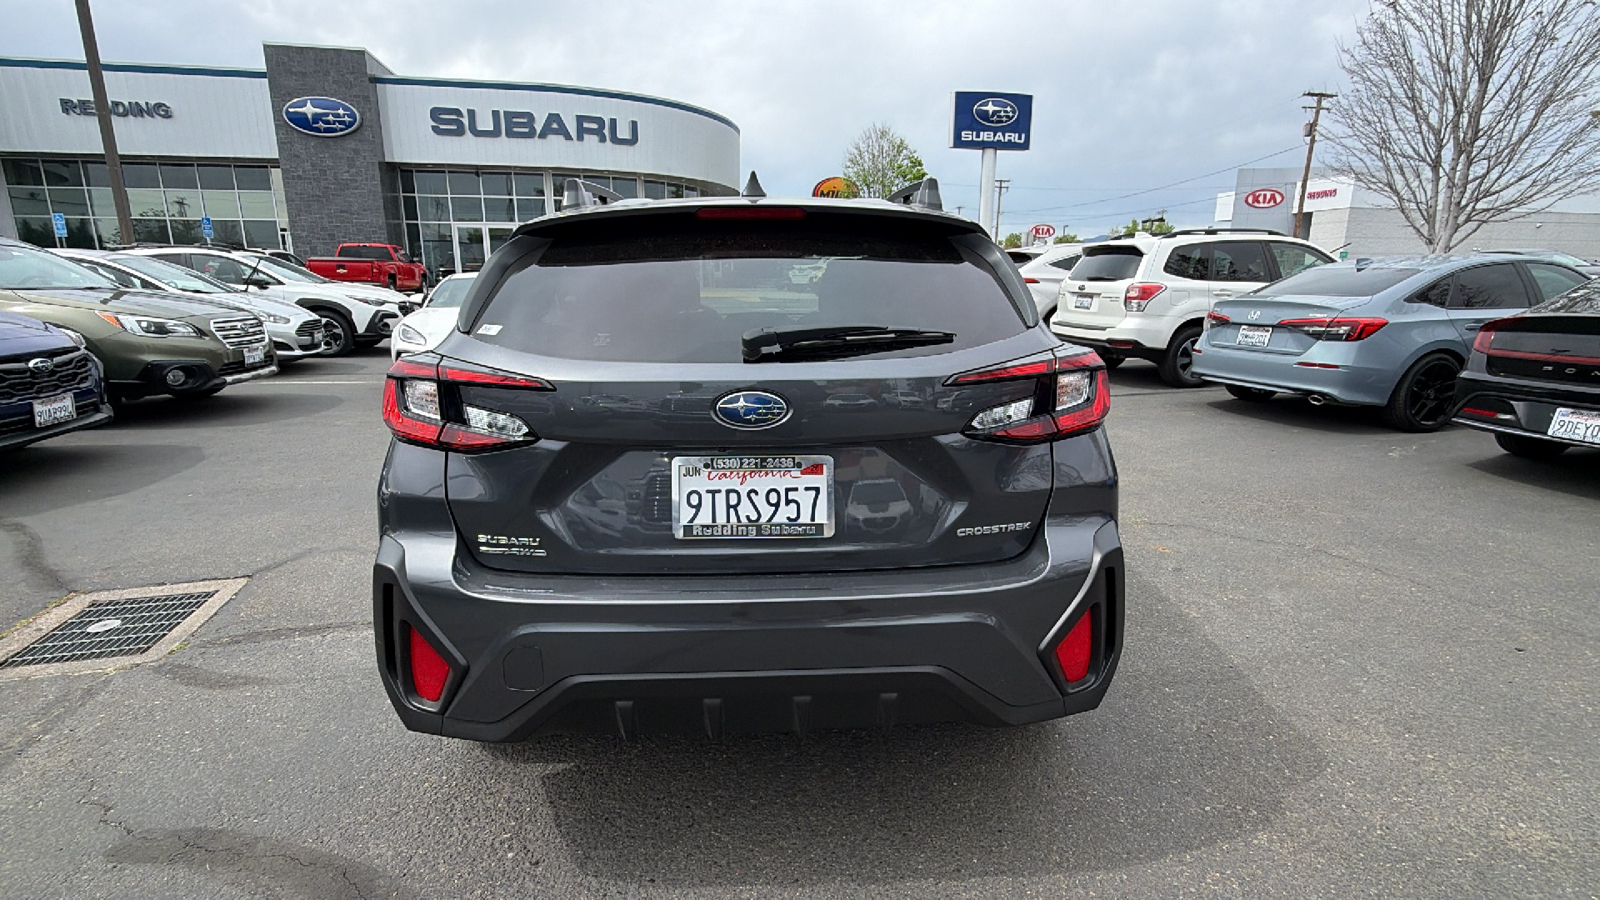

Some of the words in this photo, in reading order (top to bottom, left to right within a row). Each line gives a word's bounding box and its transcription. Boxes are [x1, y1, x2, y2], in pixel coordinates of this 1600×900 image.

[59, 98, 173, 119] REDING
[429, 106, 639, 146] SUBARU
[961, 131, 1025, 144] SUBARU
[1251, 193, 1277, 204] KIA
[1034, 227, 1051, 236] KIA
[683, 466, 701, 477] JUN
[686, 486, 821, 524] 9TRS957
[692, 524, 757, 536] Redding
[761, 524, 815, 535] Subaru
[956, 521, 1031, 537] CROSSTREK
[477, 534, 540, 545] SUBARU
